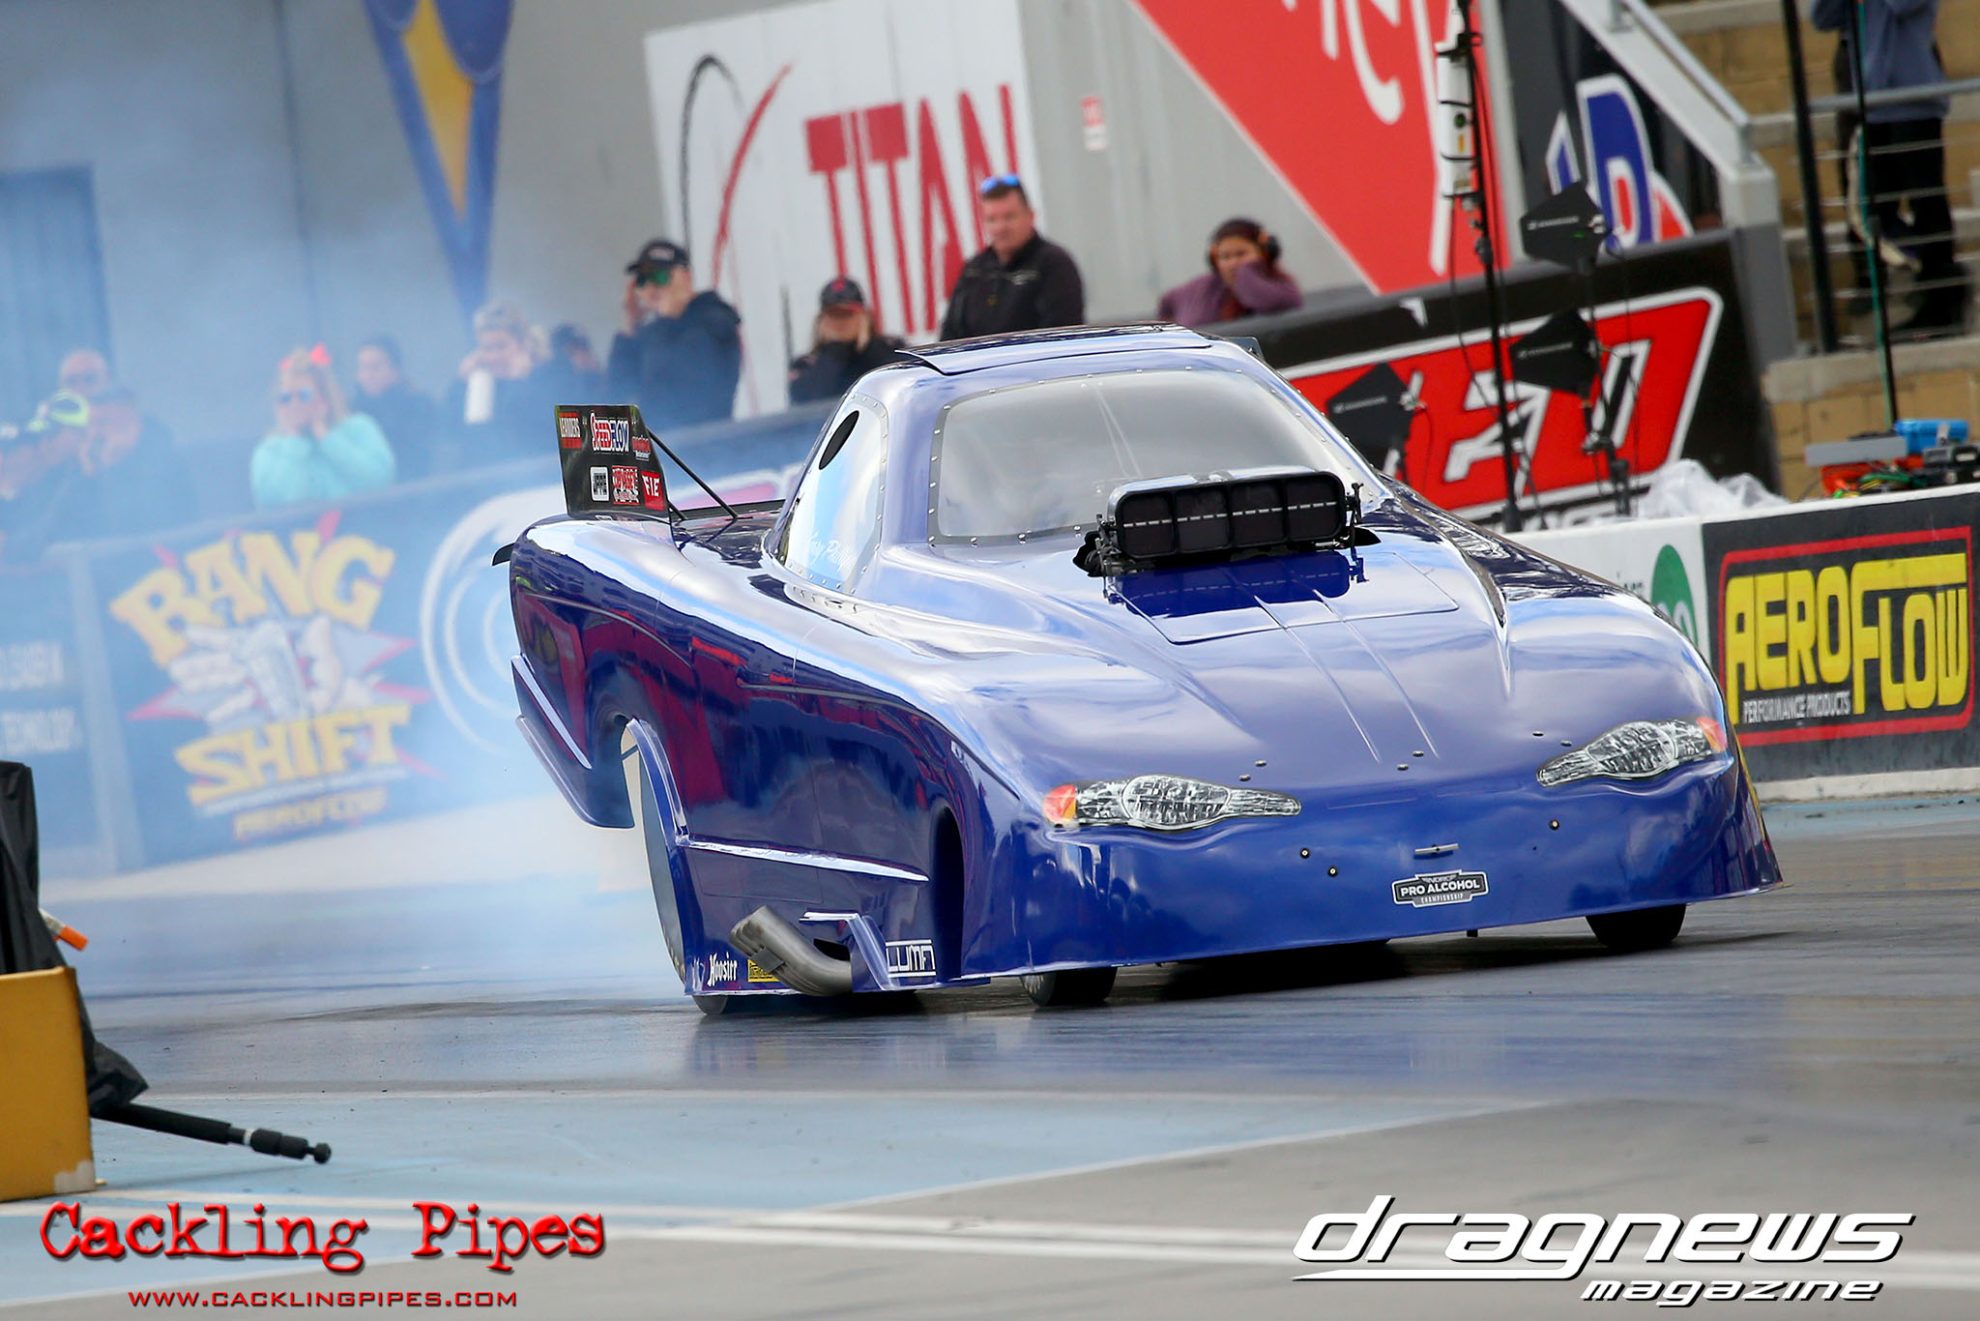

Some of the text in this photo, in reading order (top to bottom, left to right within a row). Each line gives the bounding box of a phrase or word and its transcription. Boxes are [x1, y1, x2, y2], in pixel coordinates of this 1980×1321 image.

[642, 474, 661, 497] FIE
[110, 530, 396, 669] BANG
[1724, 552, 1969, 726] AEROFLOW
[174, 703, 412, 807] SHIFT
[1400, 884, 1425, 897] PRO
[1427, 879, 1480, 893] ALCOHOL
